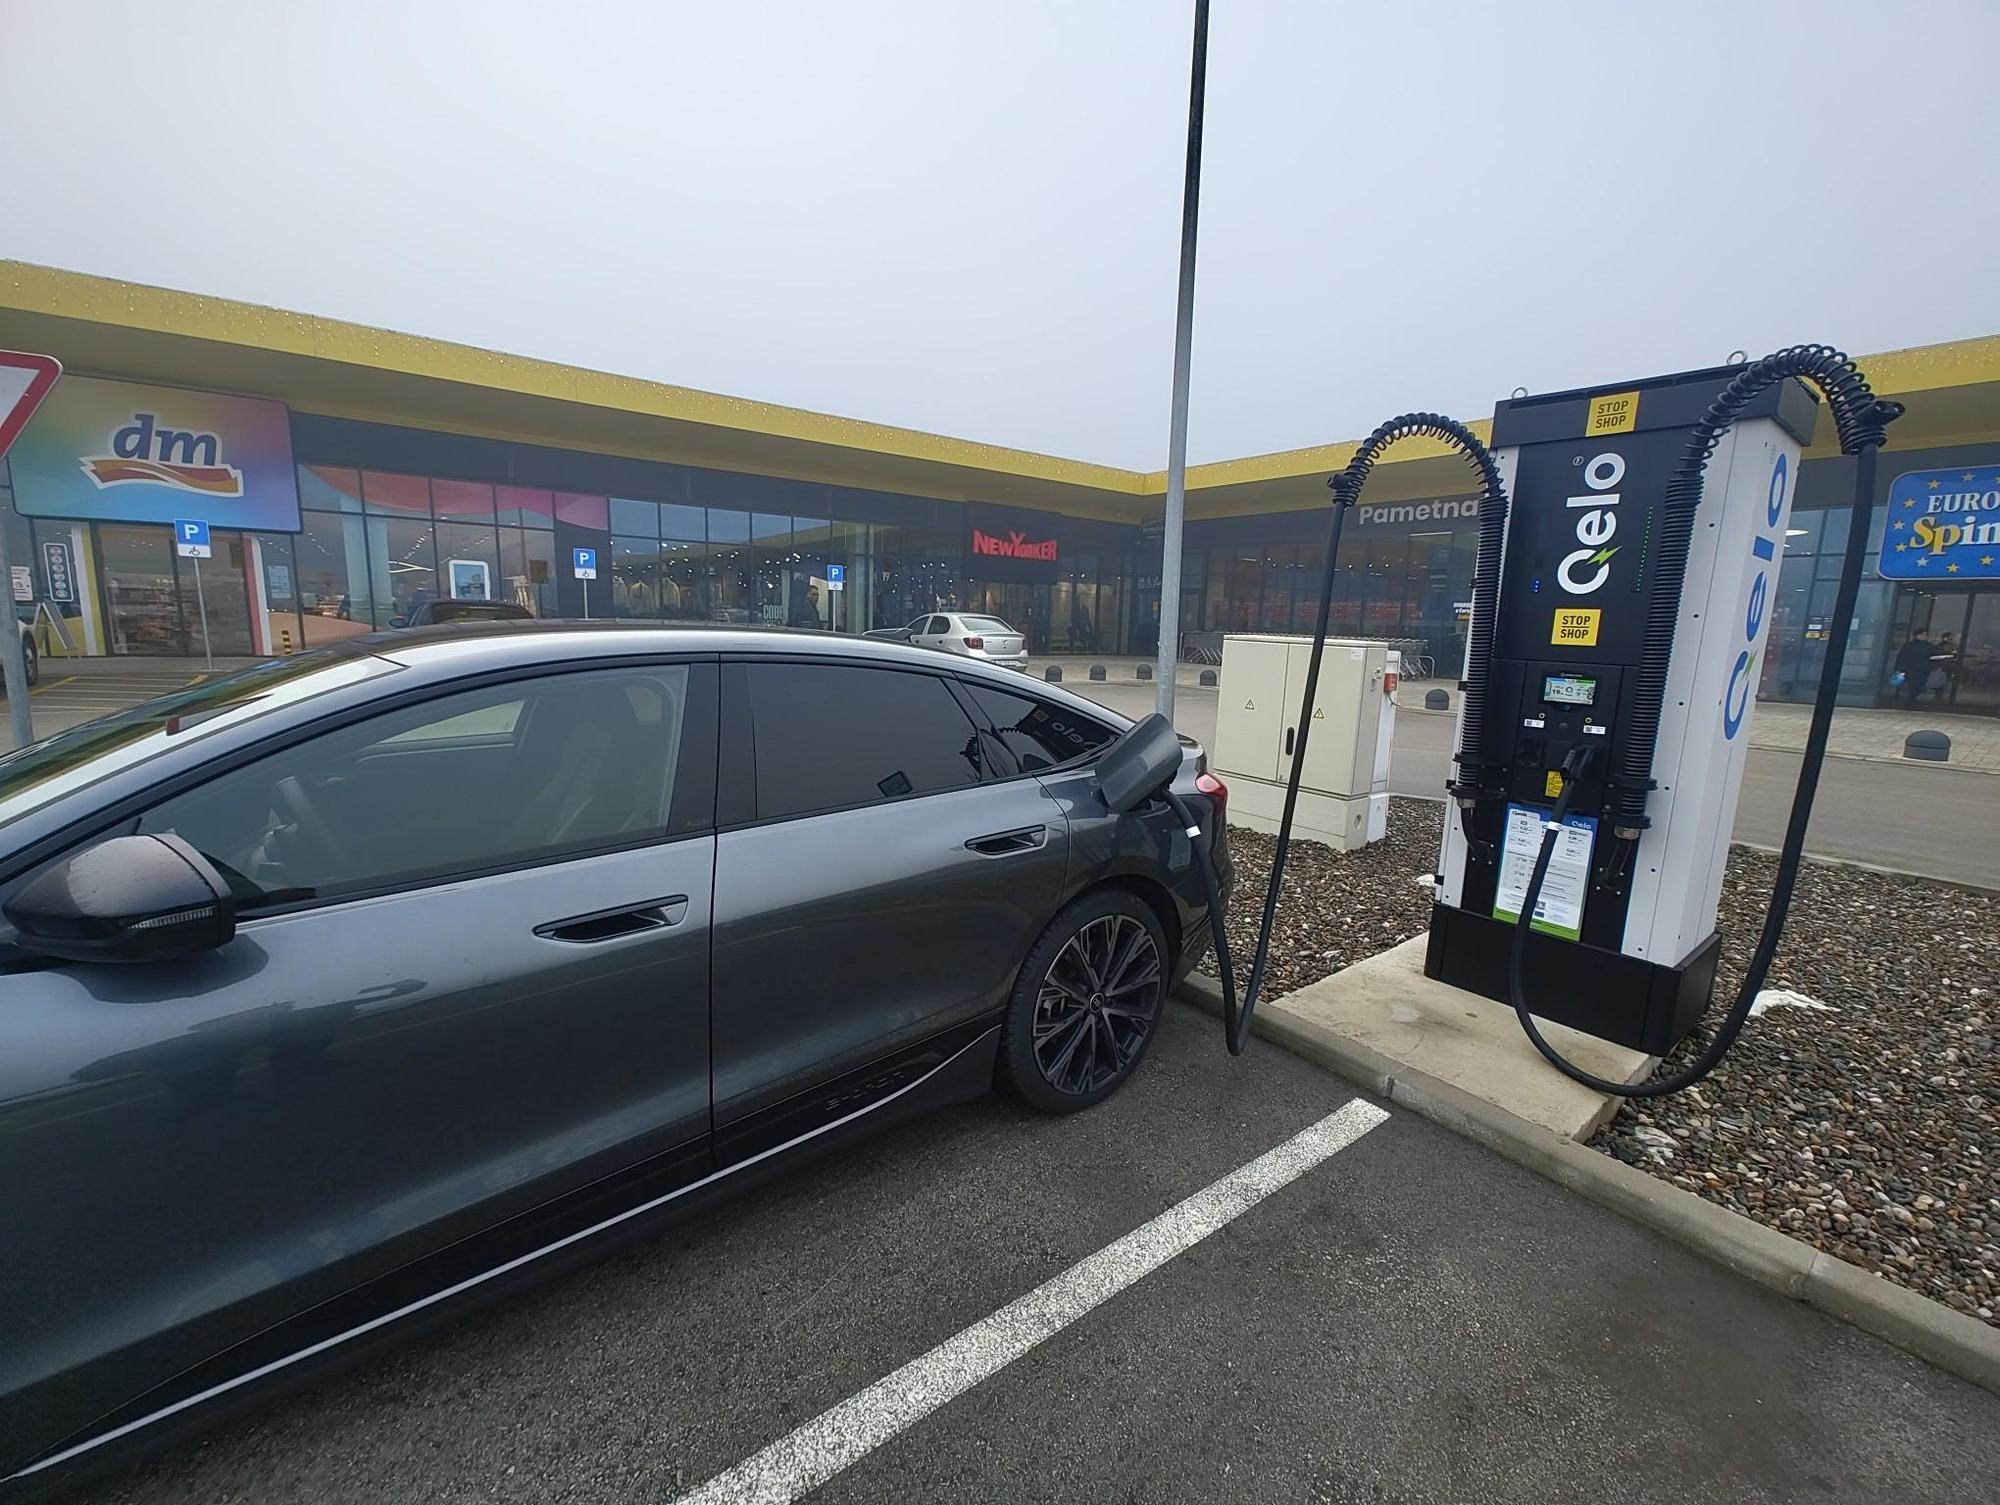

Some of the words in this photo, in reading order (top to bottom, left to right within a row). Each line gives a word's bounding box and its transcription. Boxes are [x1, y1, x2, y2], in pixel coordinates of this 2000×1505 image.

[1597, 400, 1629, 415] STOP
[1595, 415, 1627, 430] SHOP
[113, 413, 217, 466] dm
[1926, 490, 2000, 514] EURO
[1359, 500, 1480, 525] Pametna
[184, 524, 200, 540] P
[580, 552, 590, 565] P
[832, 568, 839, 578] P
[1562, 615, 1591, 625] STOP
[1560, 629, 1589, 639] SHOP
